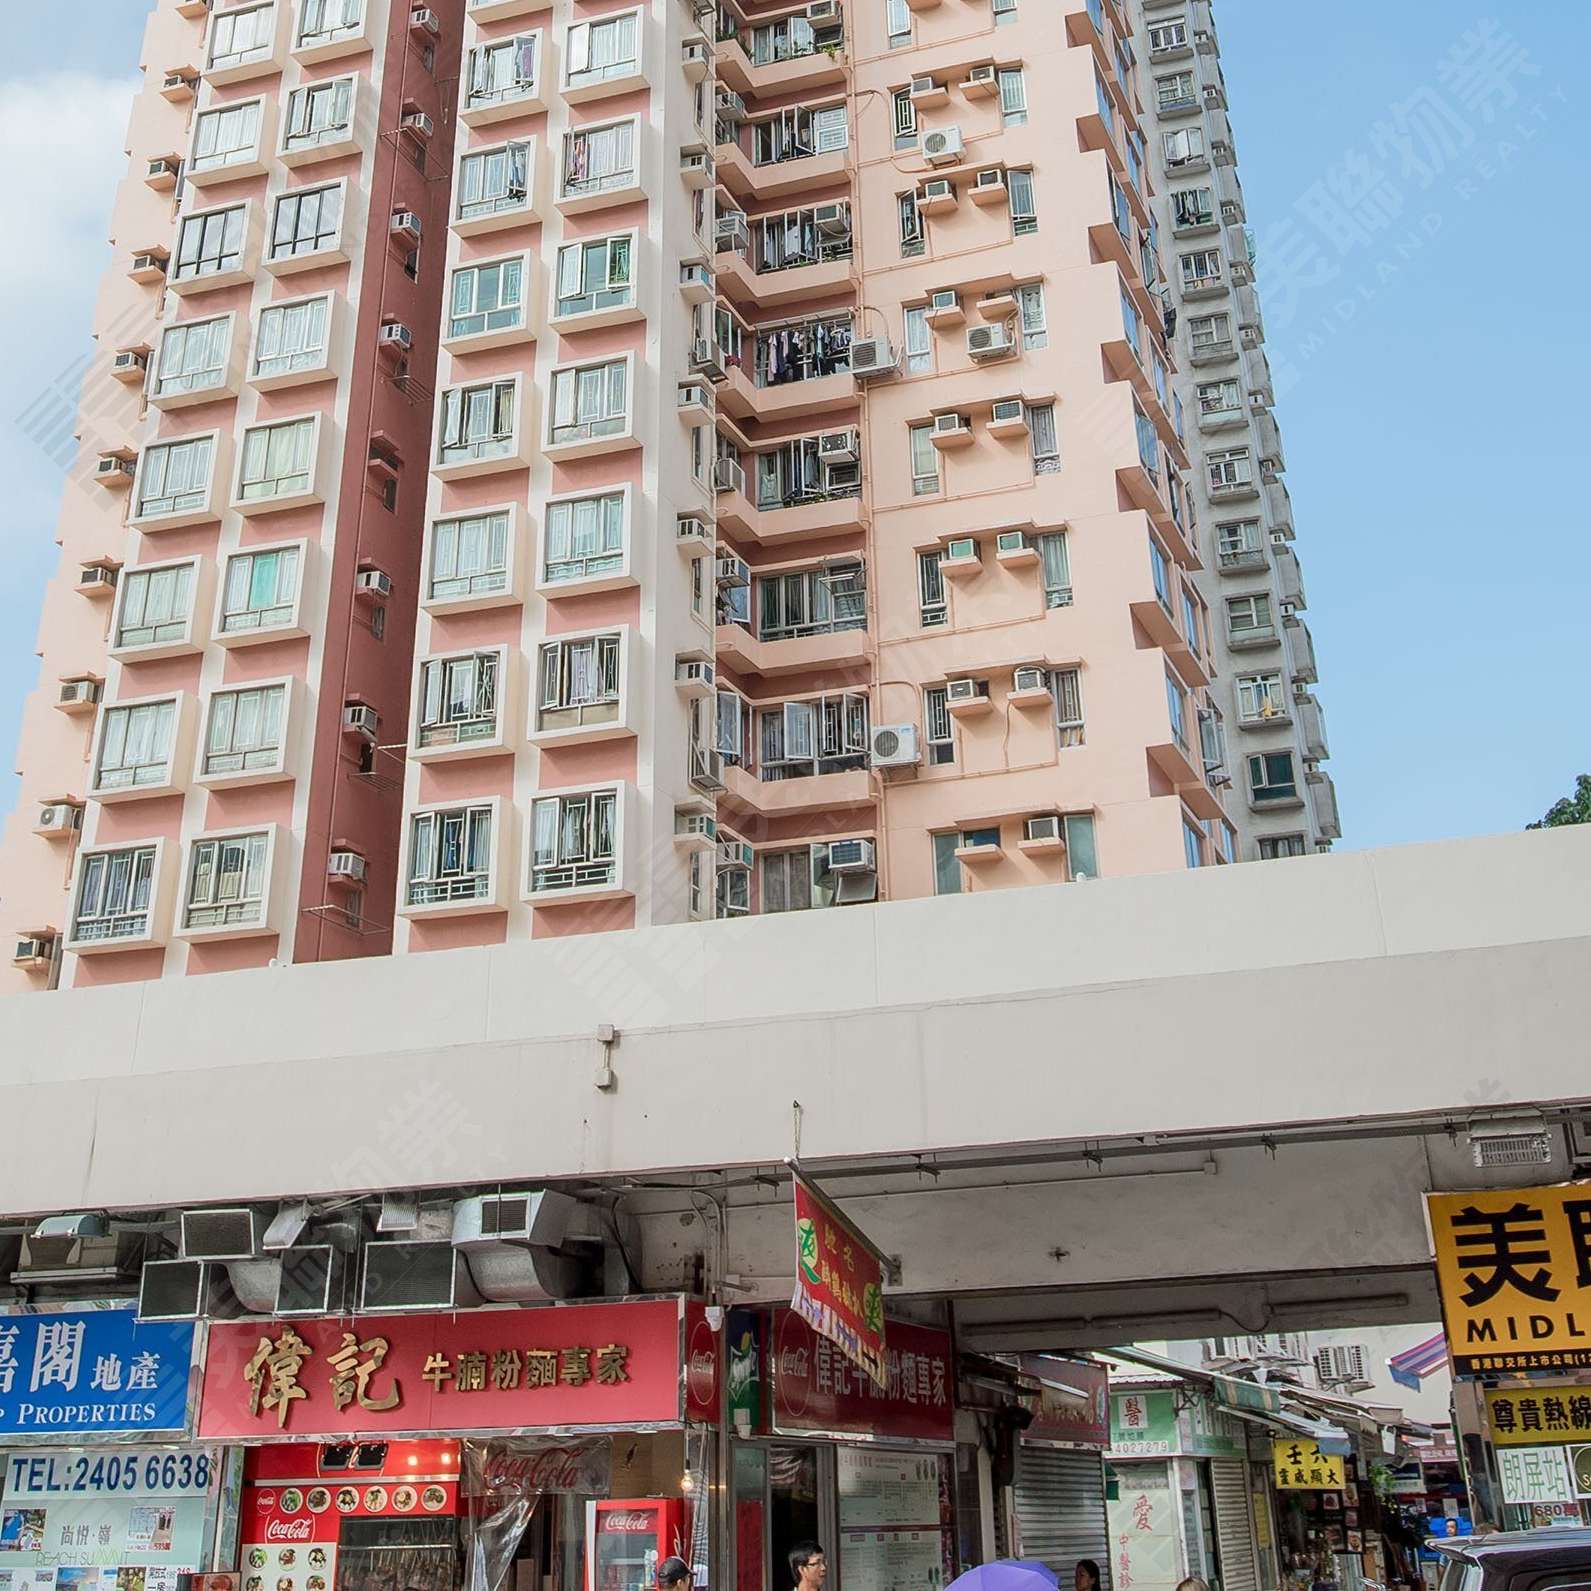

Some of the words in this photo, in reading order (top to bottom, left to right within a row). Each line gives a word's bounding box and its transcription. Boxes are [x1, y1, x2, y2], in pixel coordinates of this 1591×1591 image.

[242, 1324, 403, 1429] 偉記
[421, 1343, 628, 1393] 牛腩粉麵專家
[12, 1455, 139, 1493] TEL:2405
[144, 1453, 209, 1490] 6638
[267, 1518, 313, 1540] Coca-Cola
